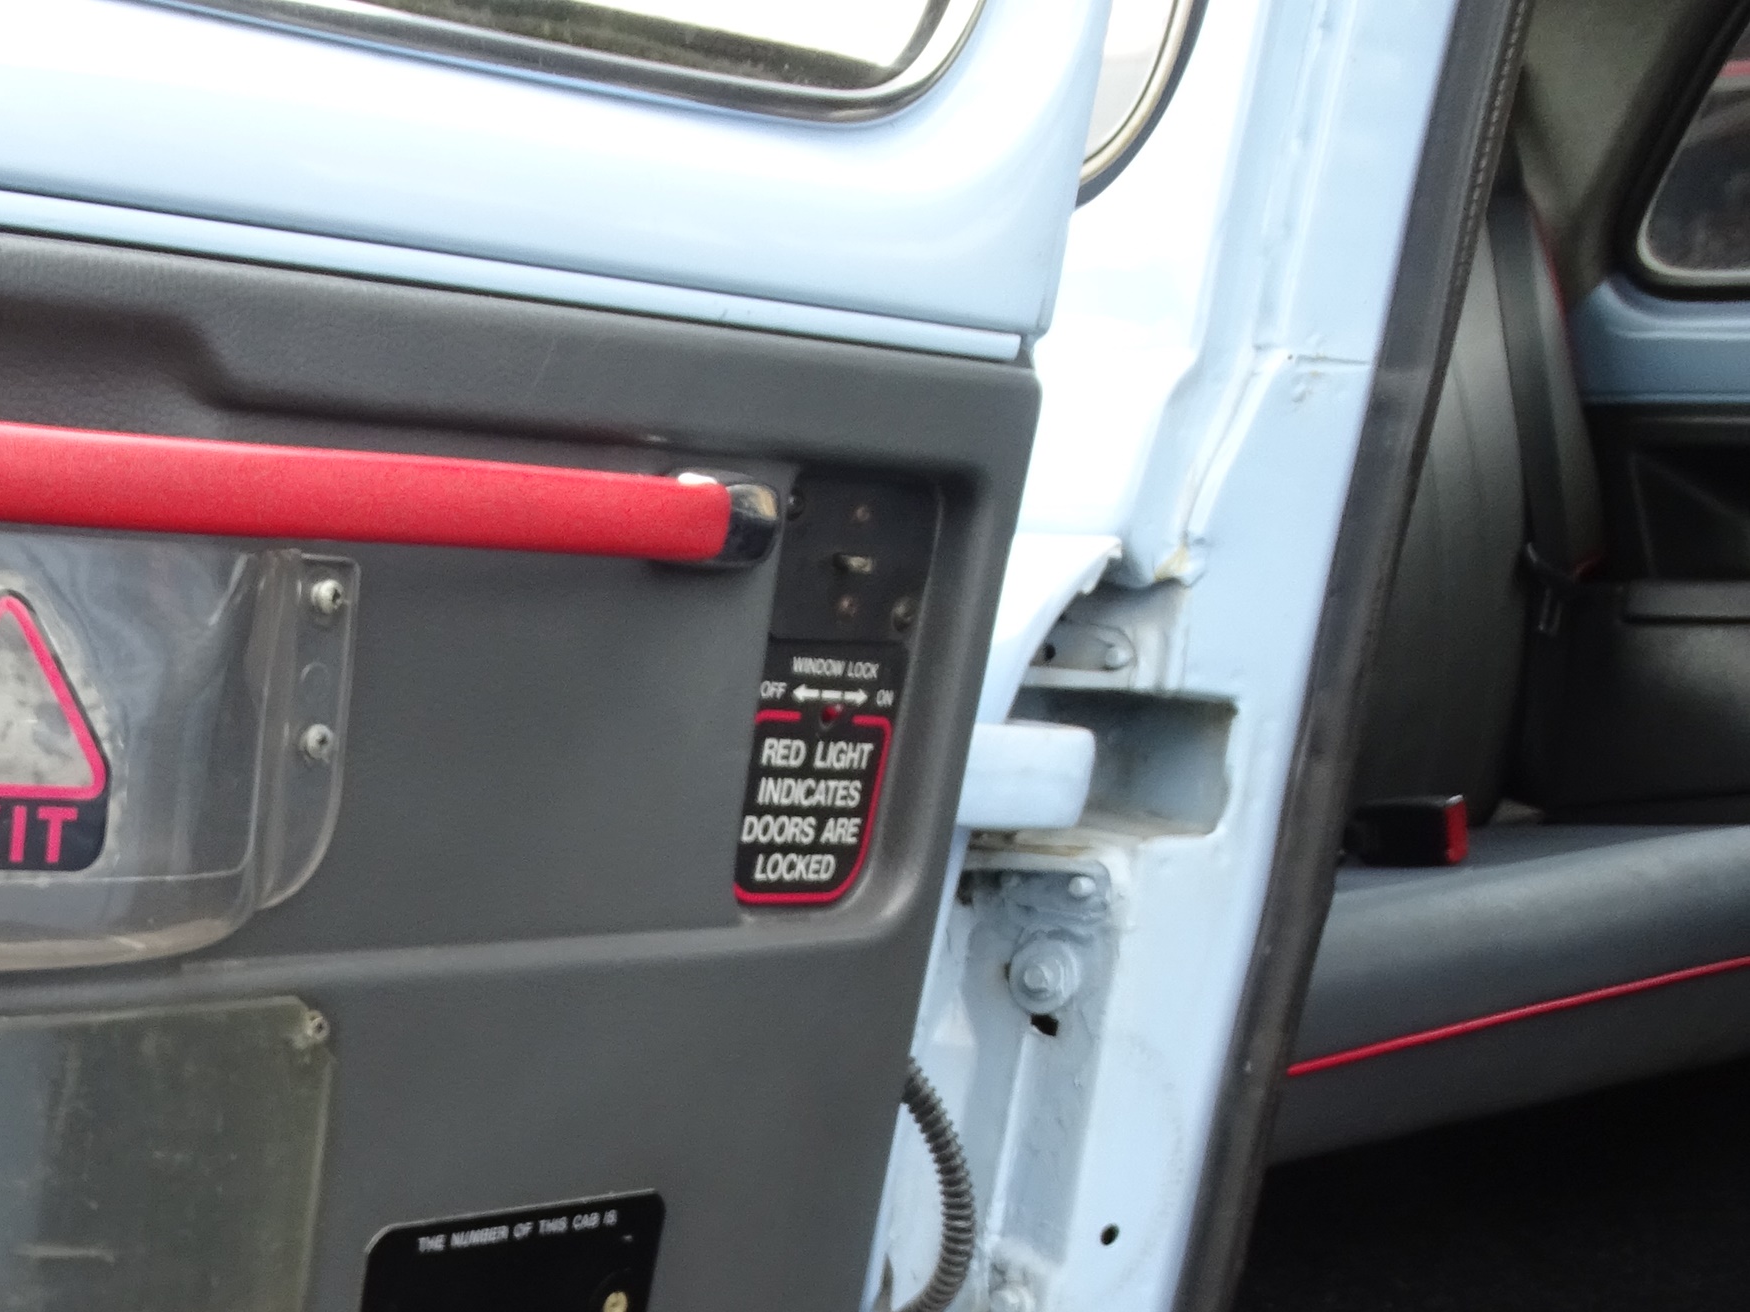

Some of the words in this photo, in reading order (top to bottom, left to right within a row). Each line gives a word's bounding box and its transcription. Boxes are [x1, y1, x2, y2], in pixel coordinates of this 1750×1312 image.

[792, 656, 845, 677] WINDOW
[847, 661, 879, 679] LOCK
[760, 680, 787, 699] OFF
[876, 689, 894, 707] ON
[760, 738, 806, 767] RED
[813, 741, 874, 770] LIGHT
[757, 777, 862, 807] INDICATES
[741, 815, 816, 844] DOORS
[820, 818, 861, 844] ARE
[754, 853, 836, 881] LOCKED
[418, 1234, 445, 1252] THE
[451, 1225, 509, 1247] NUMBER
[513, 1221, 534, 1240] OF
[539, 1216, 568, 1235] THIS
[572, 1212, 601, 1231] CAB
[603, 1209, 618, 1226] IS
